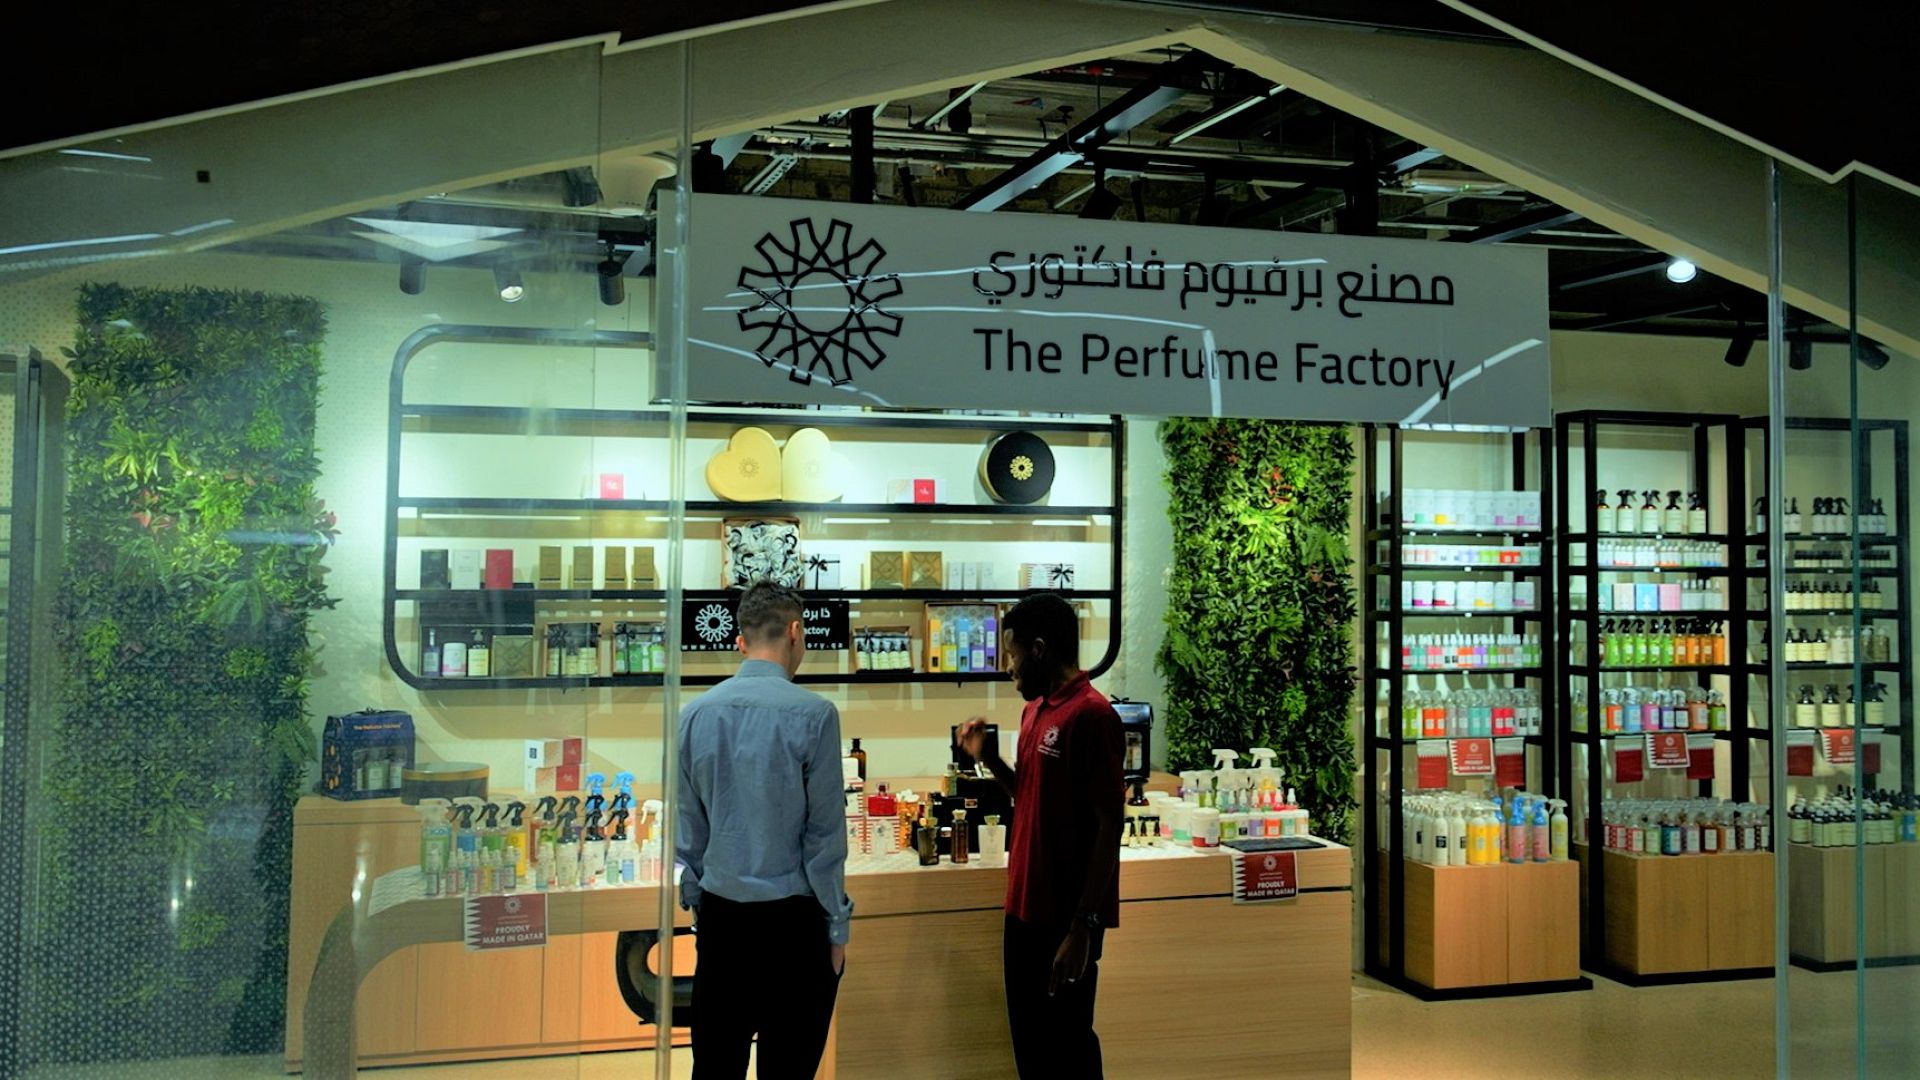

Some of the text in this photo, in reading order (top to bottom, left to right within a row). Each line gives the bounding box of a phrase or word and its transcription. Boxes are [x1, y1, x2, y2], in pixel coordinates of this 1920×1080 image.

[972, 245, 1454, 319] مصنع برفيوم فاكتوري
[973, 328, 1456, 401] The Perfume Factory
[803, 626, 831, 637] actory
[495, 924, 530, 934] PROUDLY
[482, 932, 545, 945] MADE IN QATAR
